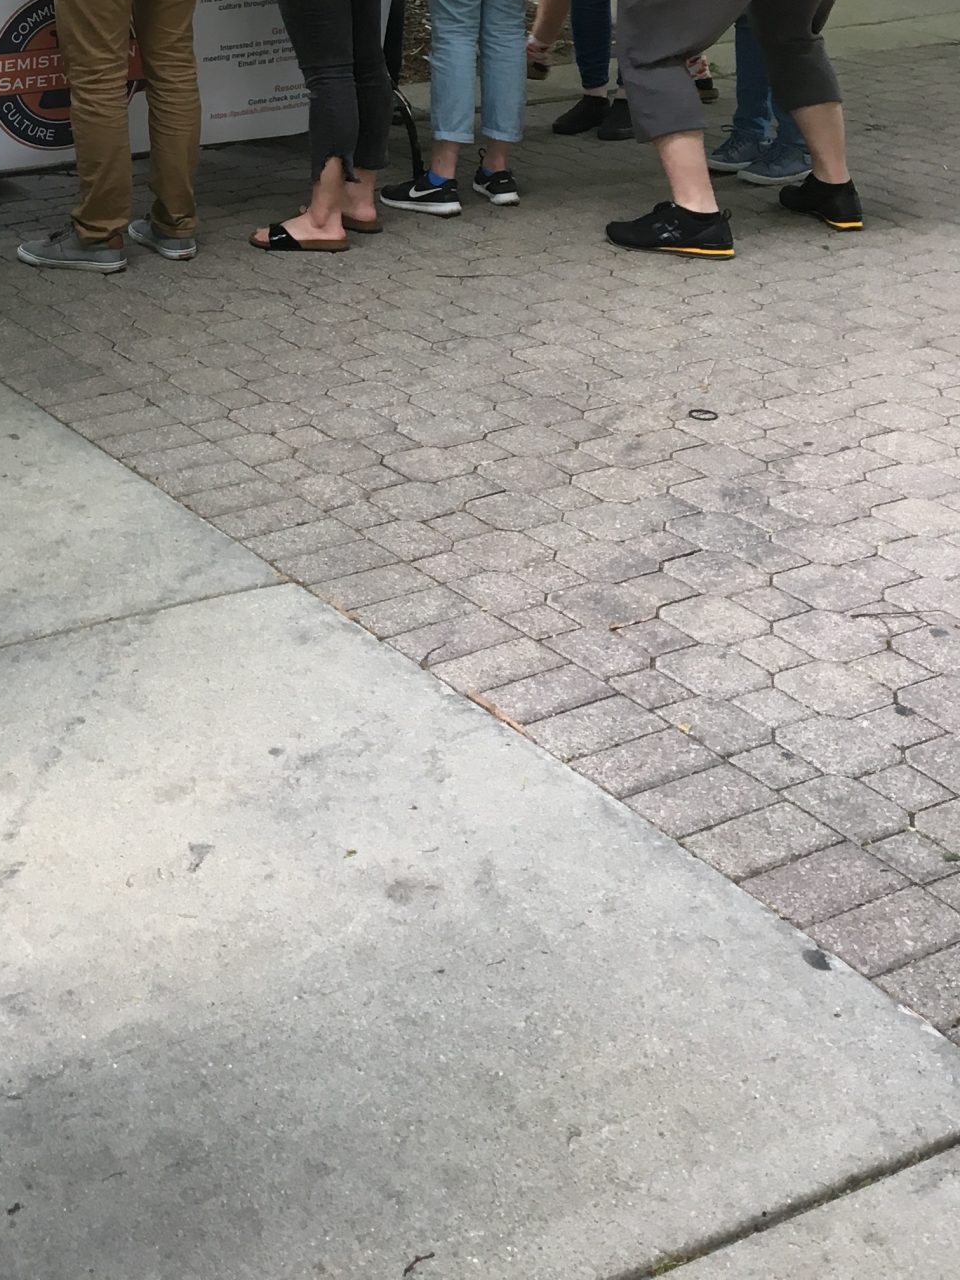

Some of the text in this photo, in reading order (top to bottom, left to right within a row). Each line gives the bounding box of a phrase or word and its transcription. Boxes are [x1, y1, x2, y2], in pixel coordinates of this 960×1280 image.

[218, 2, 242, 11] culture
[11, 4, 57, 44] COMMU
[220, 41, 254, 51] Interested
[203, 54, 230, 63] meeting
[238, 59, 256, 68] Email
[2, 101, 55, 141] CULTURE
